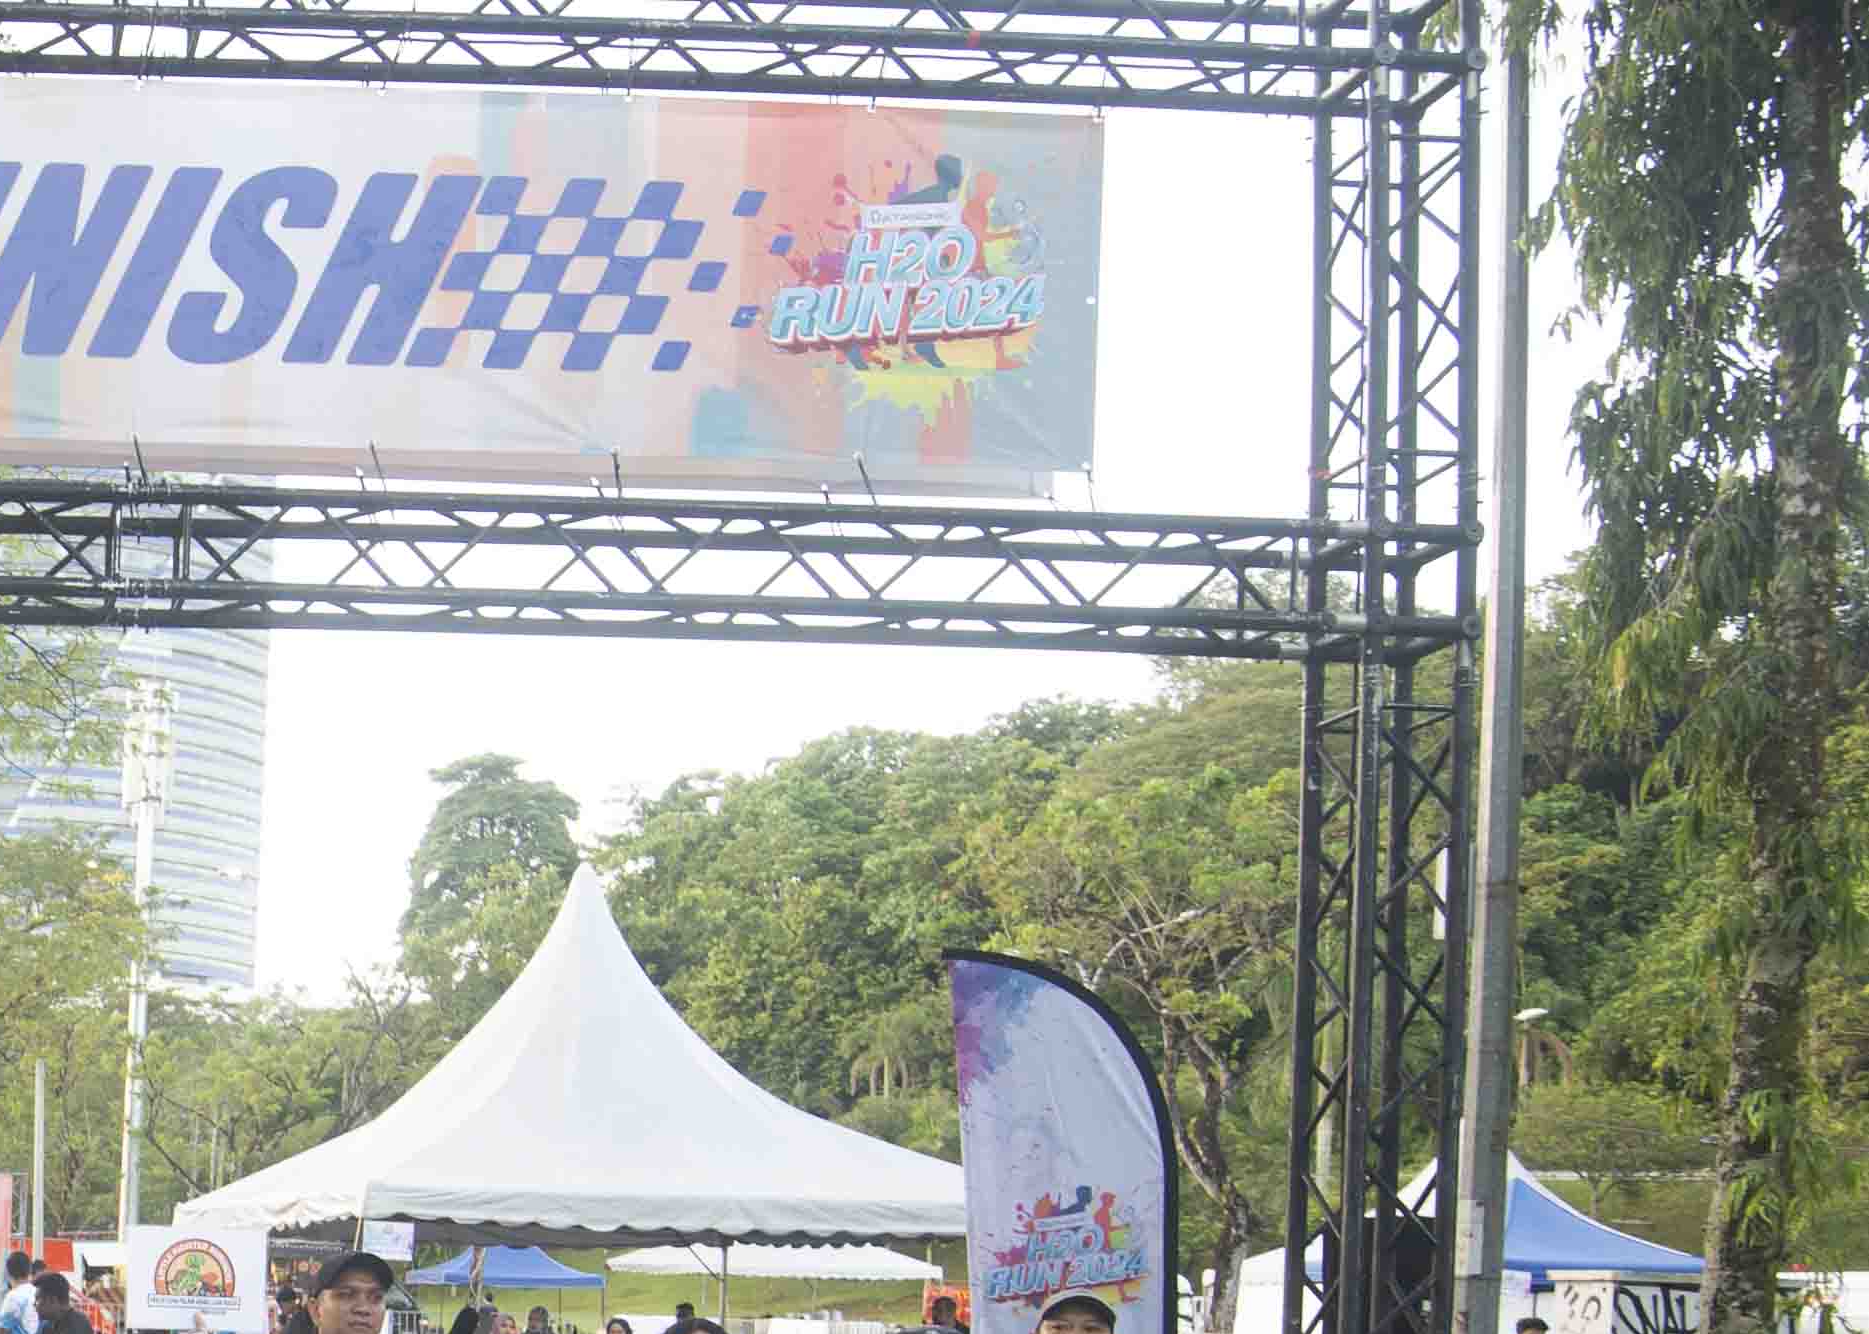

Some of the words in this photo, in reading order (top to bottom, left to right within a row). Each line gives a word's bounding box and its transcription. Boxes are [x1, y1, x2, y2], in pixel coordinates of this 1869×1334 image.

[845, 226, 977, 288] H2O
[770, 282, 905, 341] RUN
[907, 274, 1044, 331] 2024
[987, 1263, 1062, 1297] RUN
[1067, 1249, 1149, 1286] 2024
